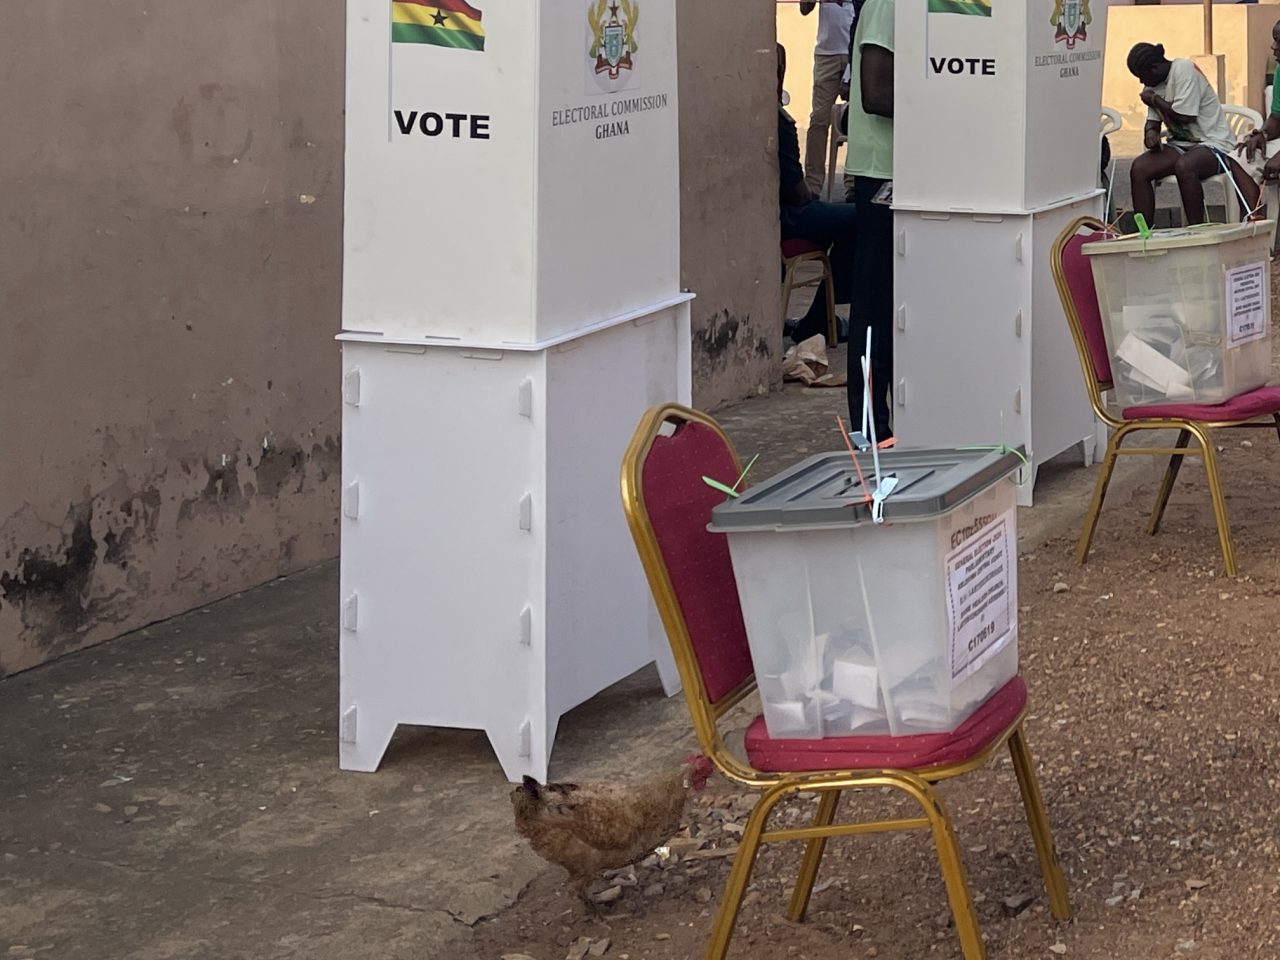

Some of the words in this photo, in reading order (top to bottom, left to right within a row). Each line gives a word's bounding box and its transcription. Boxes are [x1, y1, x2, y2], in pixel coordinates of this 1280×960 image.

[929, 56, 996, 76] VOTE
[552, 103, 609, 127] ELECTORAL
[611, 93, 668, 116] COMMISSION
[394, 110, 490, 140] VOTE
[595, 120, 630, 140] GHANA
